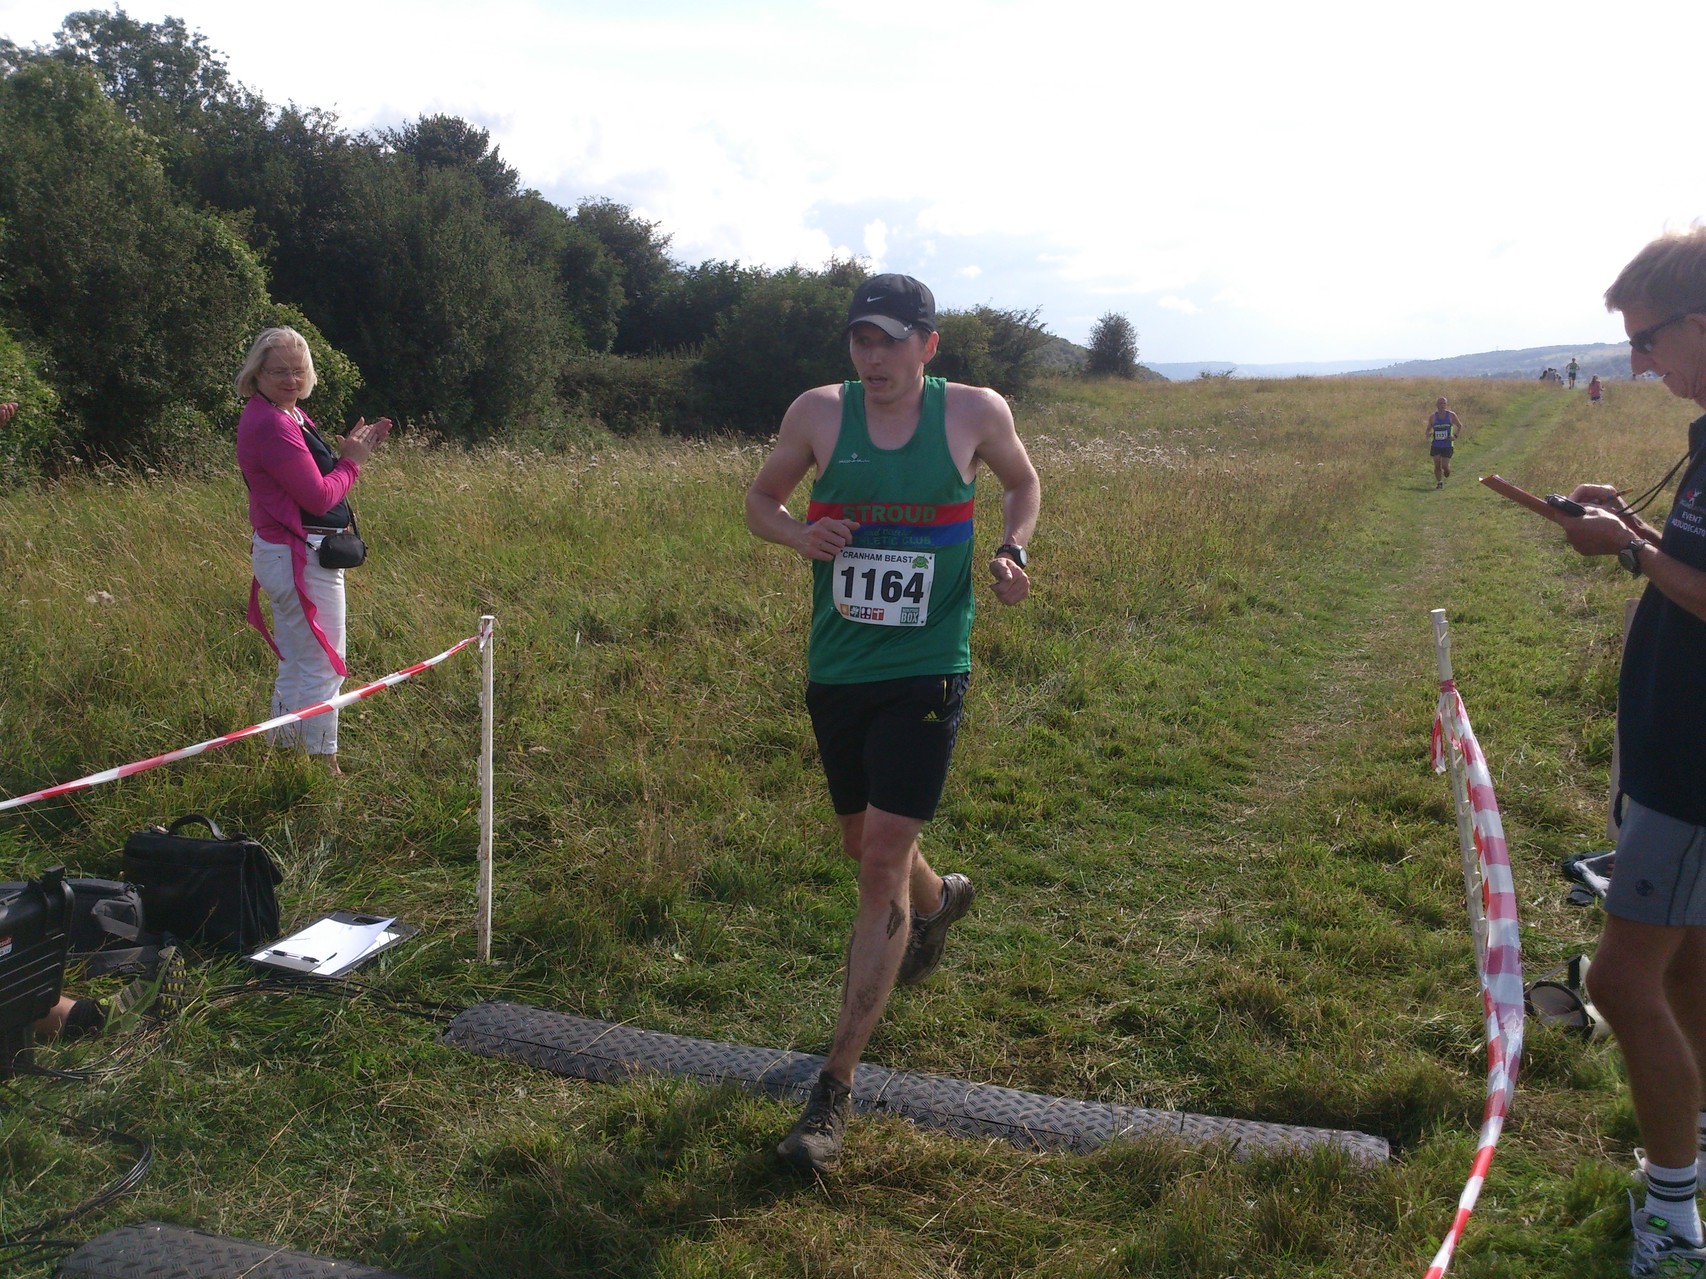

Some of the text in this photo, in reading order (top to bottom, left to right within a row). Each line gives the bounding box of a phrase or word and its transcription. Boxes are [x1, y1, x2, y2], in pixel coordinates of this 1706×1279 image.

[842, 505, 937, 523] STROUD
[1681, 511, 1703, 524] EVENT
[902, 536, 931, 545] CLUB
[842, 551, 914, 564] CRANHAM BEAST
[840, 566, 924, 604] 1164
[901, 612, 918, 623] BOX
